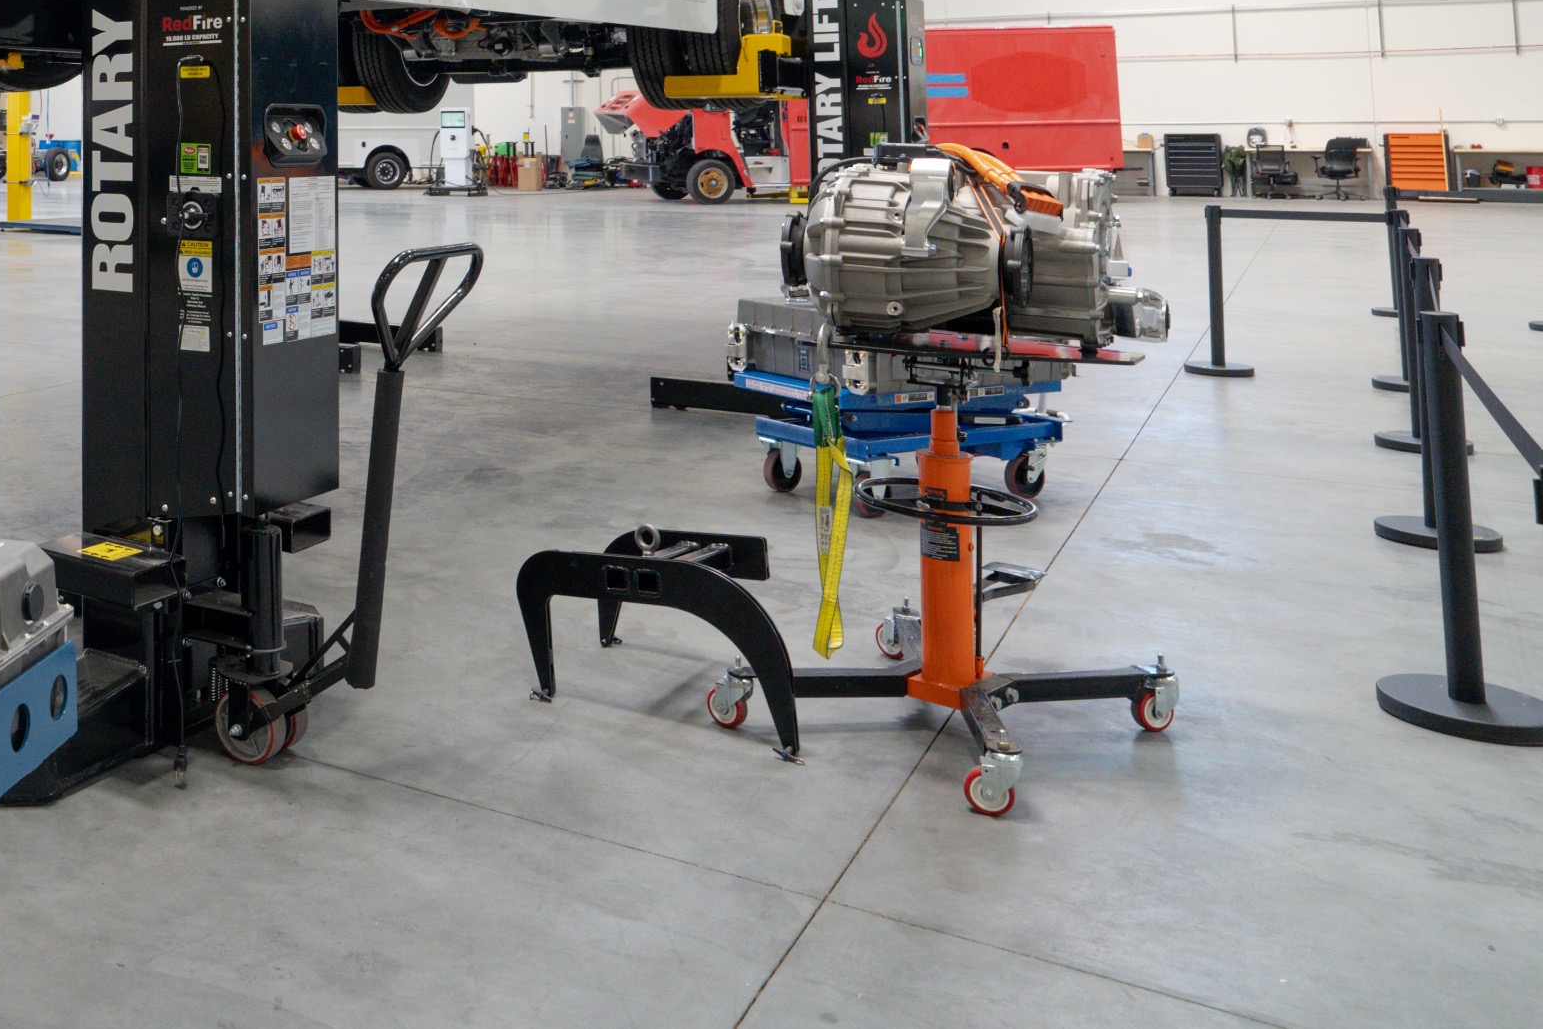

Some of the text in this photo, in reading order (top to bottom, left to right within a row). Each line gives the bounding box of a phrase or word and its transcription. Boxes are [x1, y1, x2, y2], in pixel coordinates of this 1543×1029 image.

[162, 12, 223, 32] RedFire
[856, 75, 892, 83] RedFire
[91, 9, 133, 293] ROTARY
